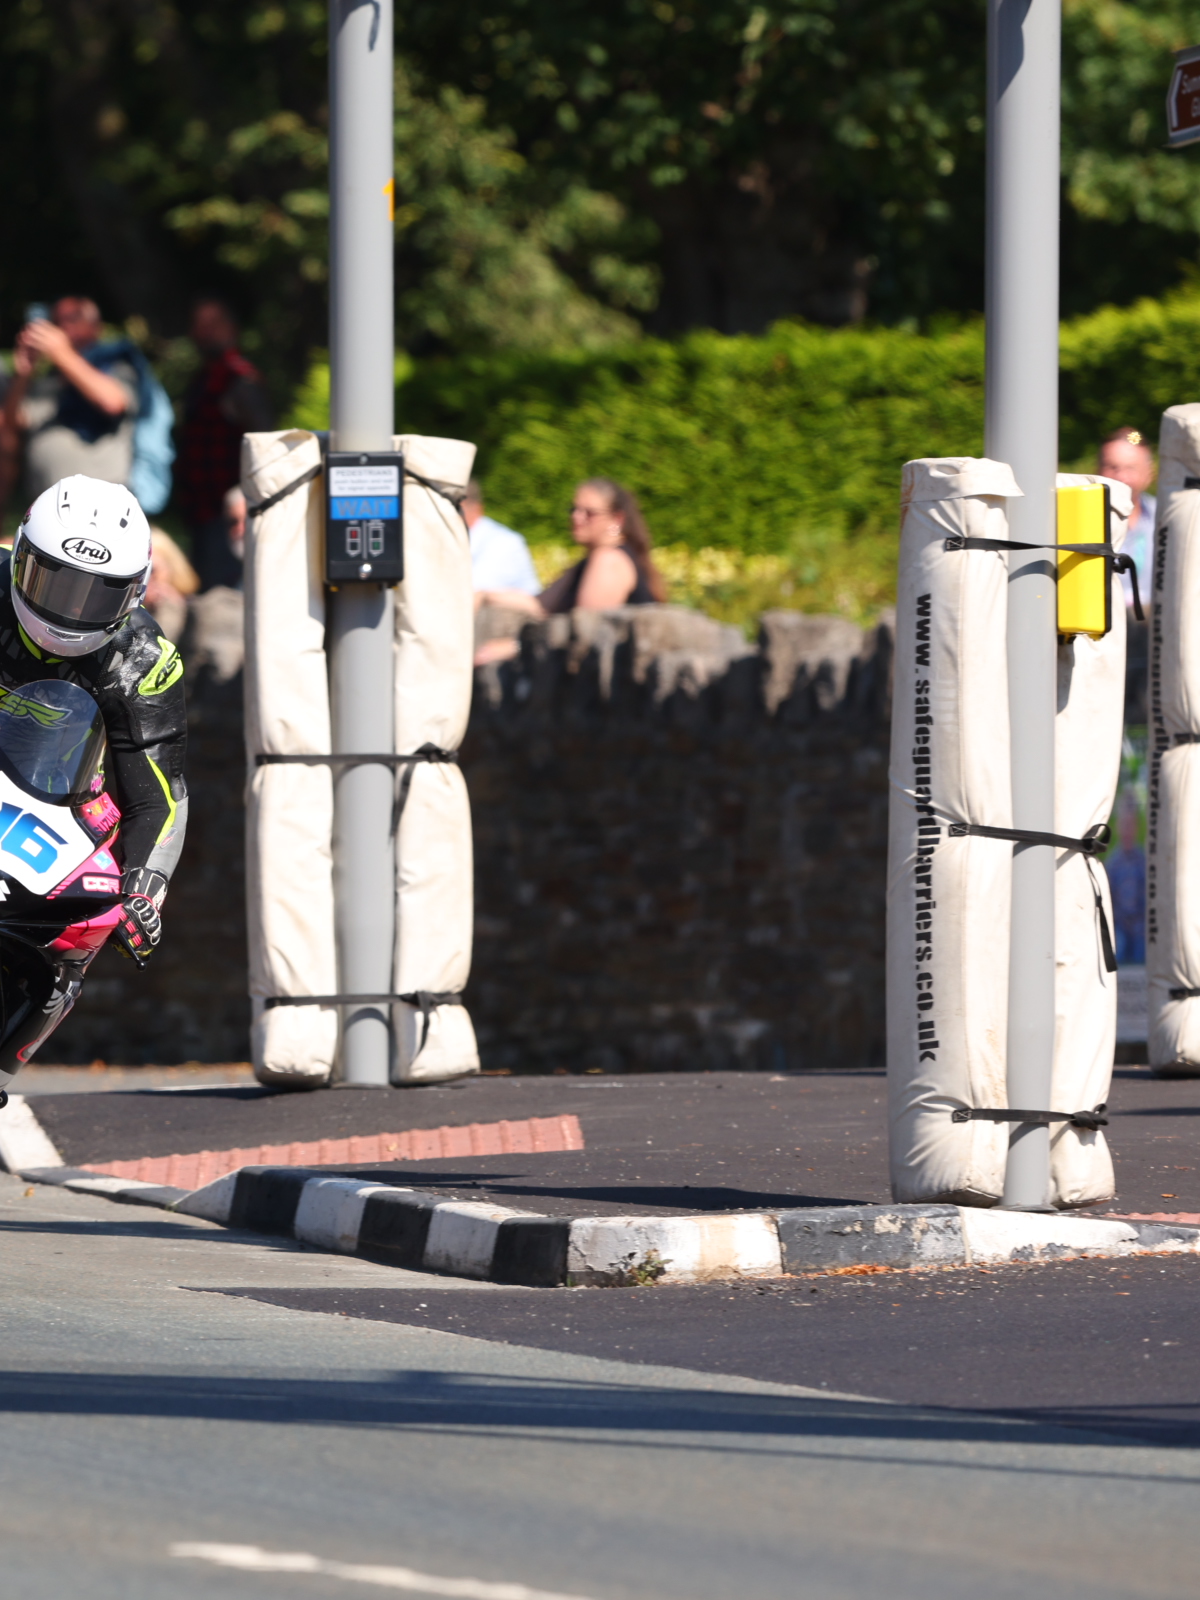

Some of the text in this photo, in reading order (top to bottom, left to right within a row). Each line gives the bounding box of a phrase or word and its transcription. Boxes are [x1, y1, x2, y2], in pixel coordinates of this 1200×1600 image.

[336, 499, 393, 516] WAIT
[64, 540, 107, 560] Arai
[94, 809, 122, 838] SUZUKI
